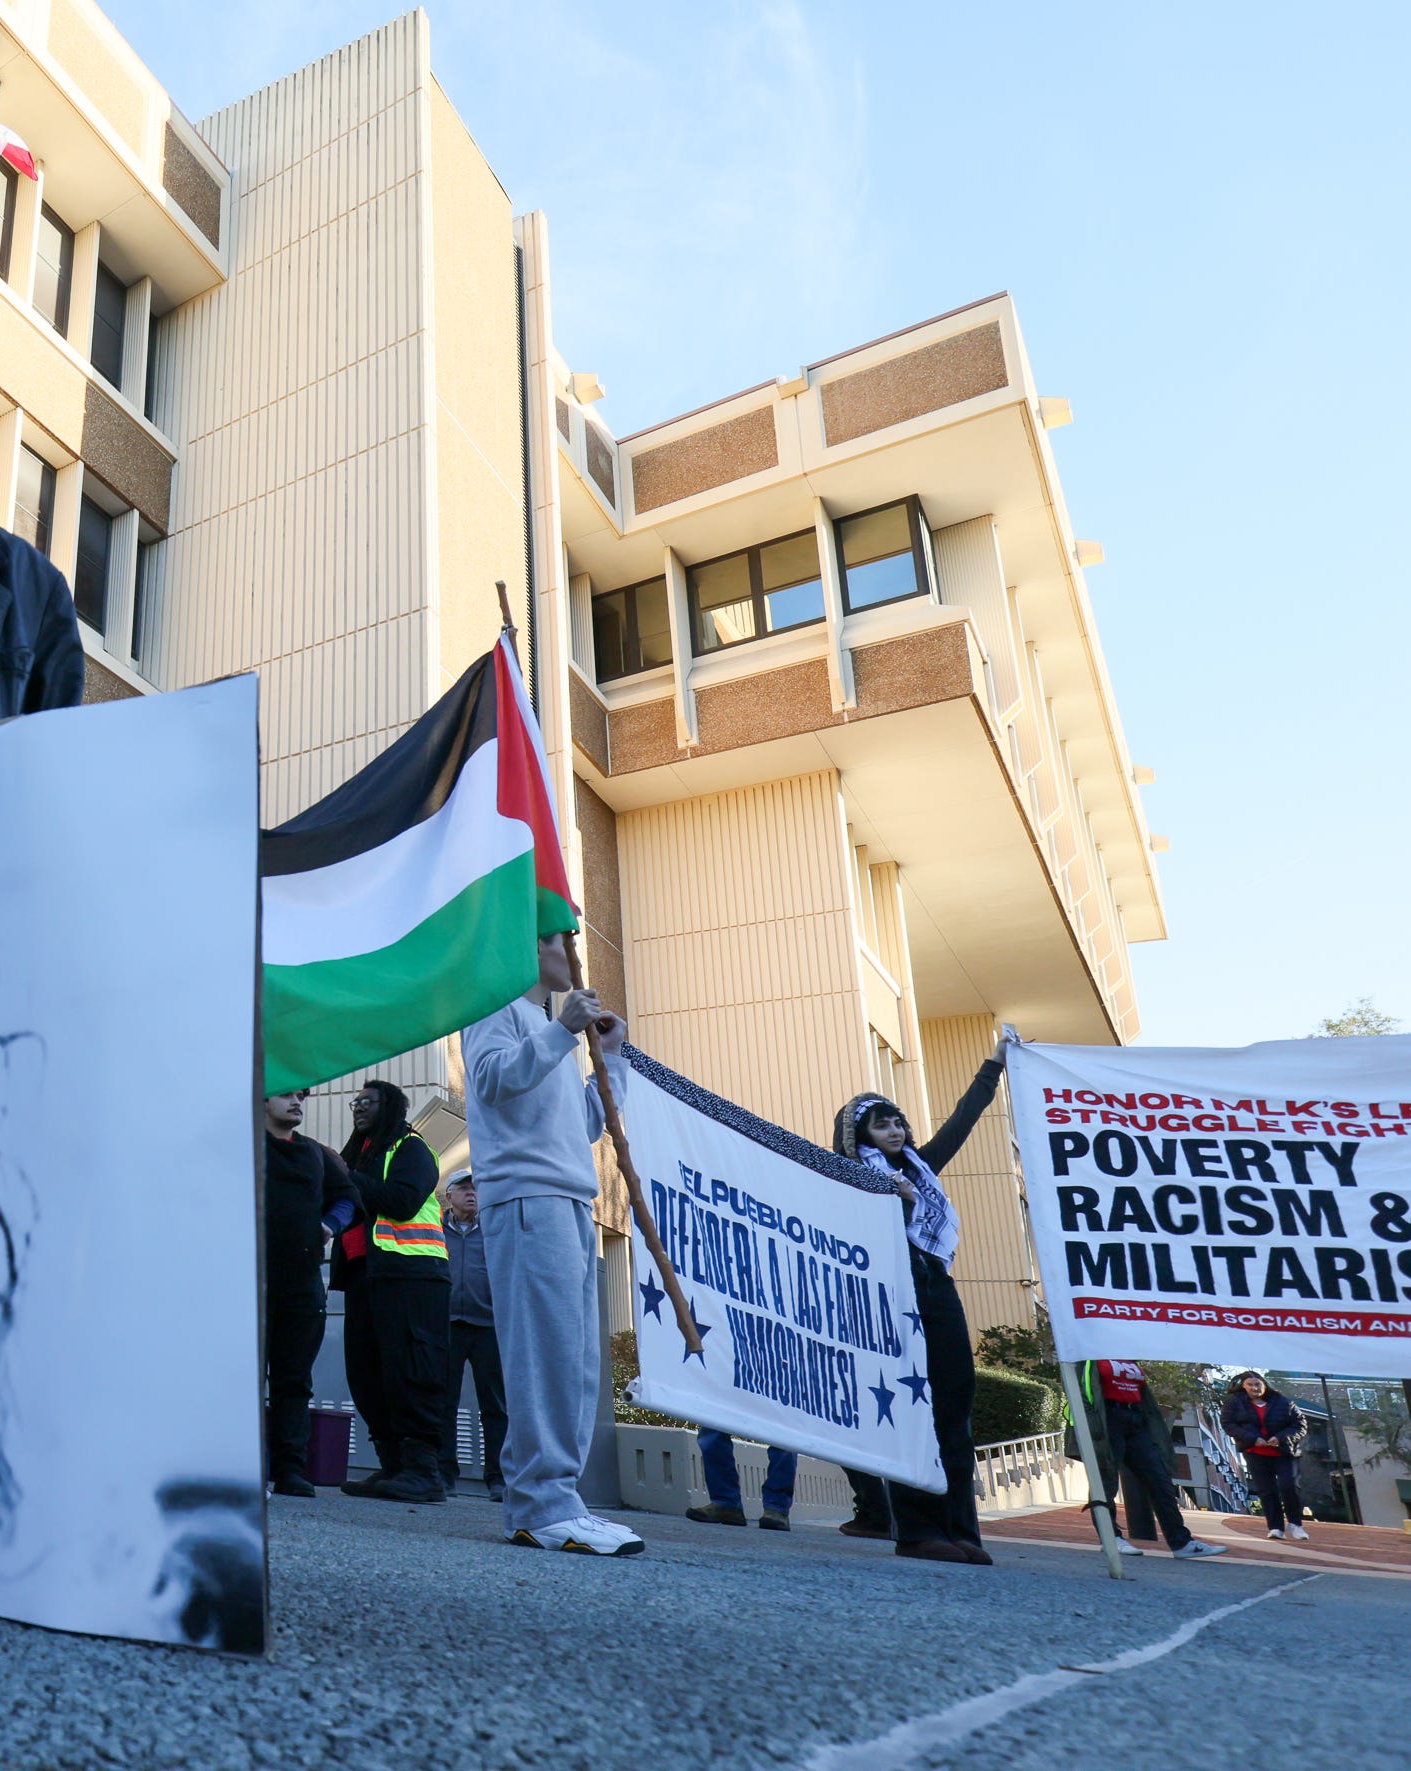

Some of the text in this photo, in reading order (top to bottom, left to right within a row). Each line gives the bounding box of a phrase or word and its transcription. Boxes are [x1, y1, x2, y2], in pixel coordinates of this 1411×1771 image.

[1042, 1088, 1205, 1110] HONOR
[1211, 1098, 1360, 1119] MLK'S
[1045, 1107, 1411, 1137] STRUGGLE FIGH
[1048, 1129, 1360, 1187] POVERTY
[711, 1179, 805, 1243] PUEBLO
[1056, 1184, 1411, 1242] RACISM &
[768, 1237, 786, 1318] A
[1084, 1303, 1411, 1333] PARTY FOR SOCIALISM AN
[1109, 1360, 1145, 1381] PSL
